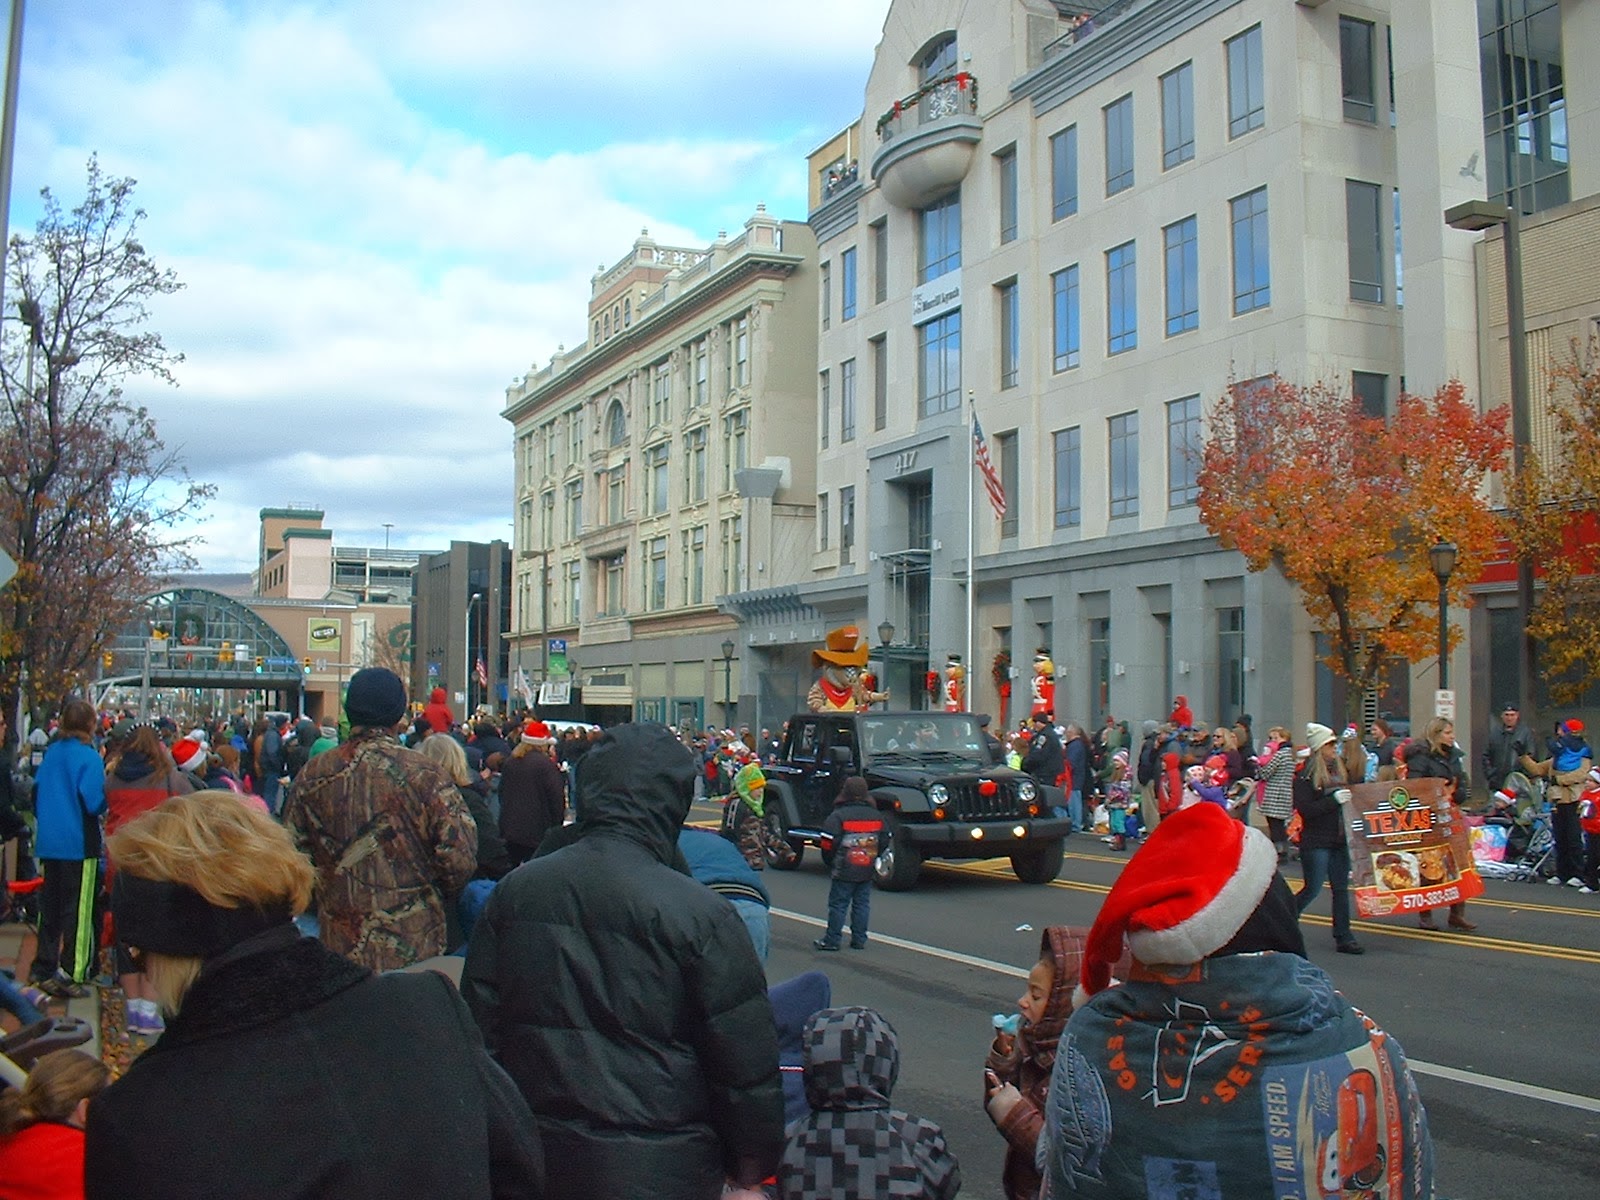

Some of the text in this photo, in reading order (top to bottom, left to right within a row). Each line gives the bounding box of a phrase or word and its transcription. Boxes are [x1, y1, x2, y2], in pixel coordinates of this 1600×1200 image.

[895, 450, 919, 474] 417
[1364, 809, 1432, 835] TEXAS
[1106, 1034, 1138, 1092] GAS
[1266, 1077, 1292, 1138] SPEED.
[1272, 1144, 1296, 1172] AM
